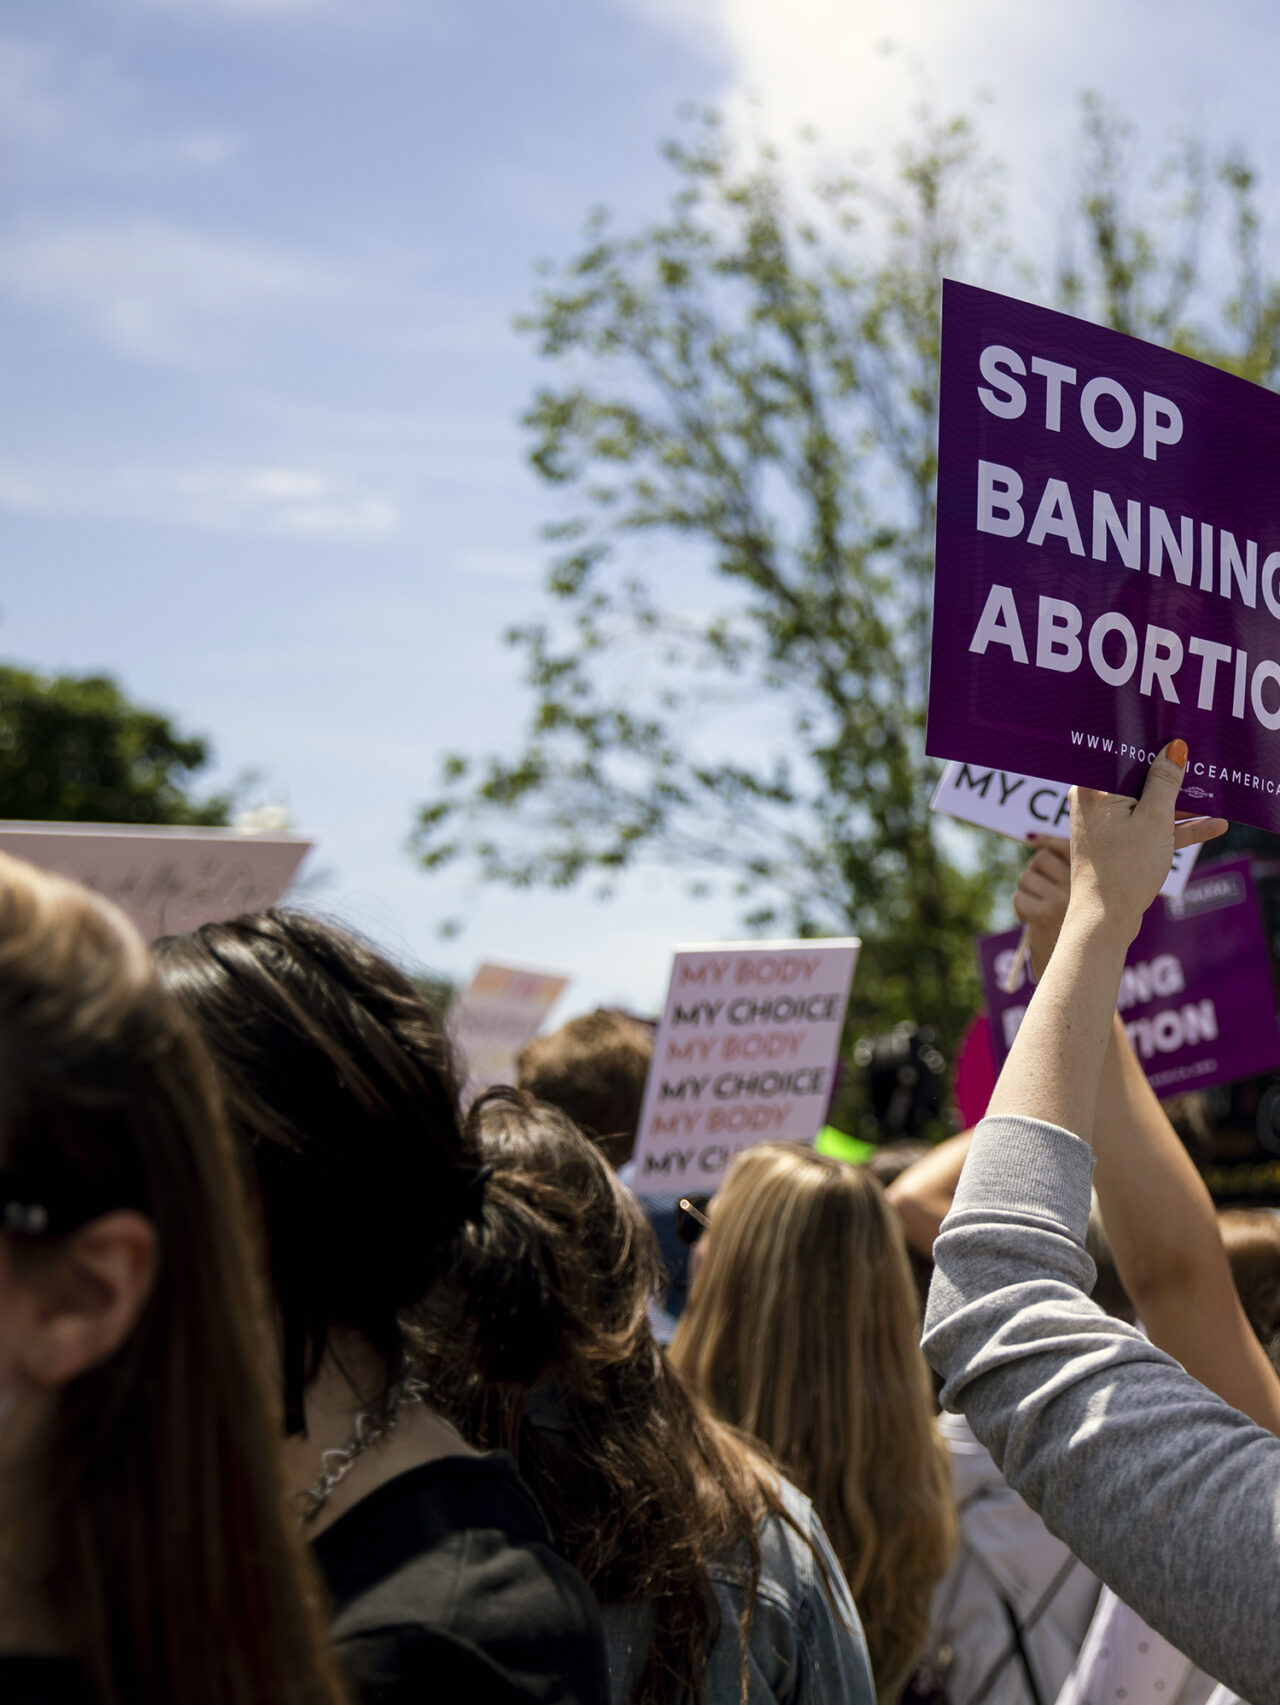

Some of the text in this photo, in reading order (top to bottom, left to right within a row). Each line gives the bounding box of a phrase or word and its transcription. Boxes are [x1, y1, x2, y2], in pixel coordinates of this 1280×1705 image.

[977, 344, 1184, 460] STOP
[954, 762, 1025, 807] MY
[678, 954, 822, 988] MY BODY
[672, 993, 841, 1028] MY CHOICE
[665, 1029, 808, 1065] MY BODY
[657, 1066, 828, 1104] MY CHOICE
[649, 1102, 795, 1136] MY BODY
[641, 1149, 697, 1178] MY
